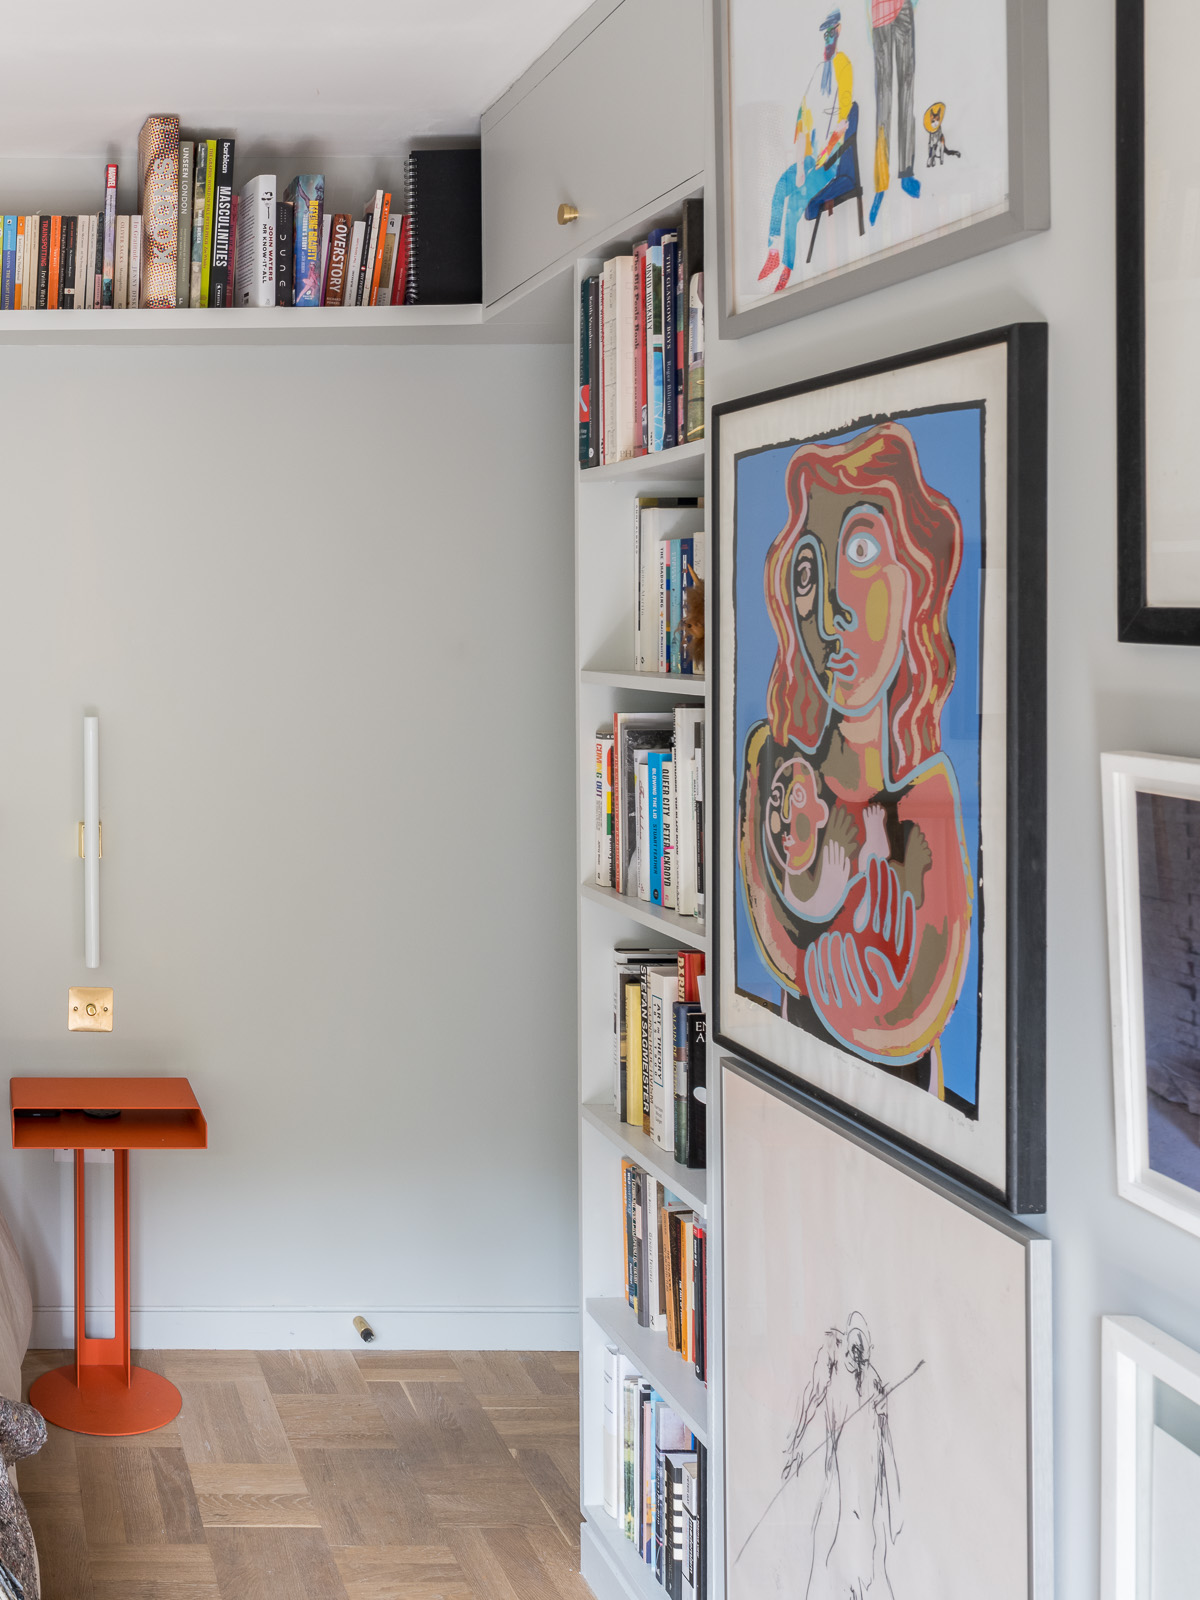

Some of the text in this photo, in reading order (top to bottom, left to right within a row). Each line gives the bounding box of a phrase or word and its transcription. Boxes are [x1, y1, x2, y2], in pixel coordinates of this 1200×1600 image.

[107, 167, 116, 187] MARVEL
[222, 142, 230, 173] barbican
[153, 158, 174, 264] KOONS
[216, 186, 231, 267] MASCULINITIES
[262, 224, 267, 235] MR
[307, 200, 319, 261] DEFYING GRAVITY
[329, 224, 348, 293] OVERSTORY
[640, 965, 649, 1113] STEFAN SAGMEISTER
